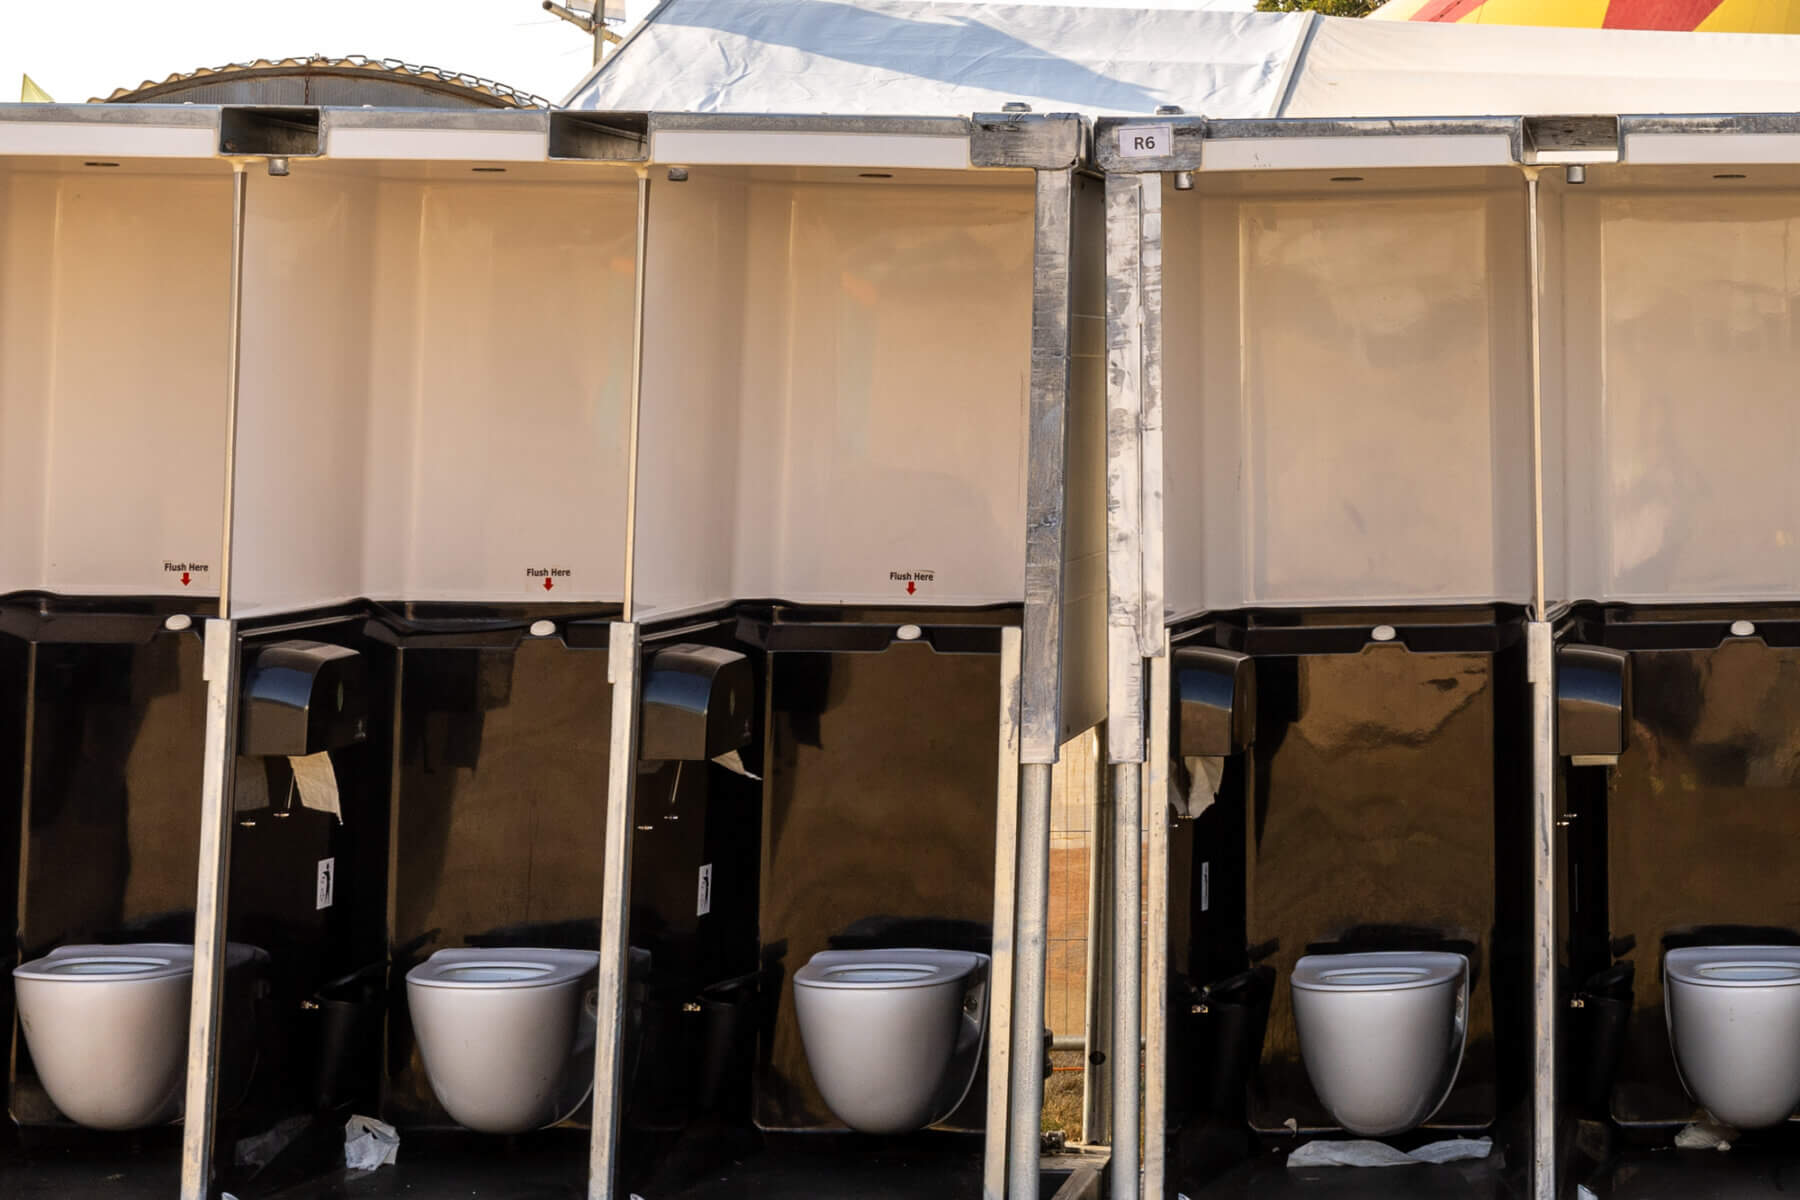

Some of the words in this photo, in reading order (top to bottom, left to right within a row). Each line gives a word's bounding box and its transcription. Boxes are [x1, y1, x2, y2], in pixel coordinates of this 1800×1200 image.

[1134, 136, 1155, 150] R6
[164, 563, 187, 571] Flush
[189, 562, 208, 572] Here
[527, 568, 549, 576] Flush
[551, 568, 571, 576] Here
[890, 571, 911, 580] Flush
[914, 572, 934, 581] Here
